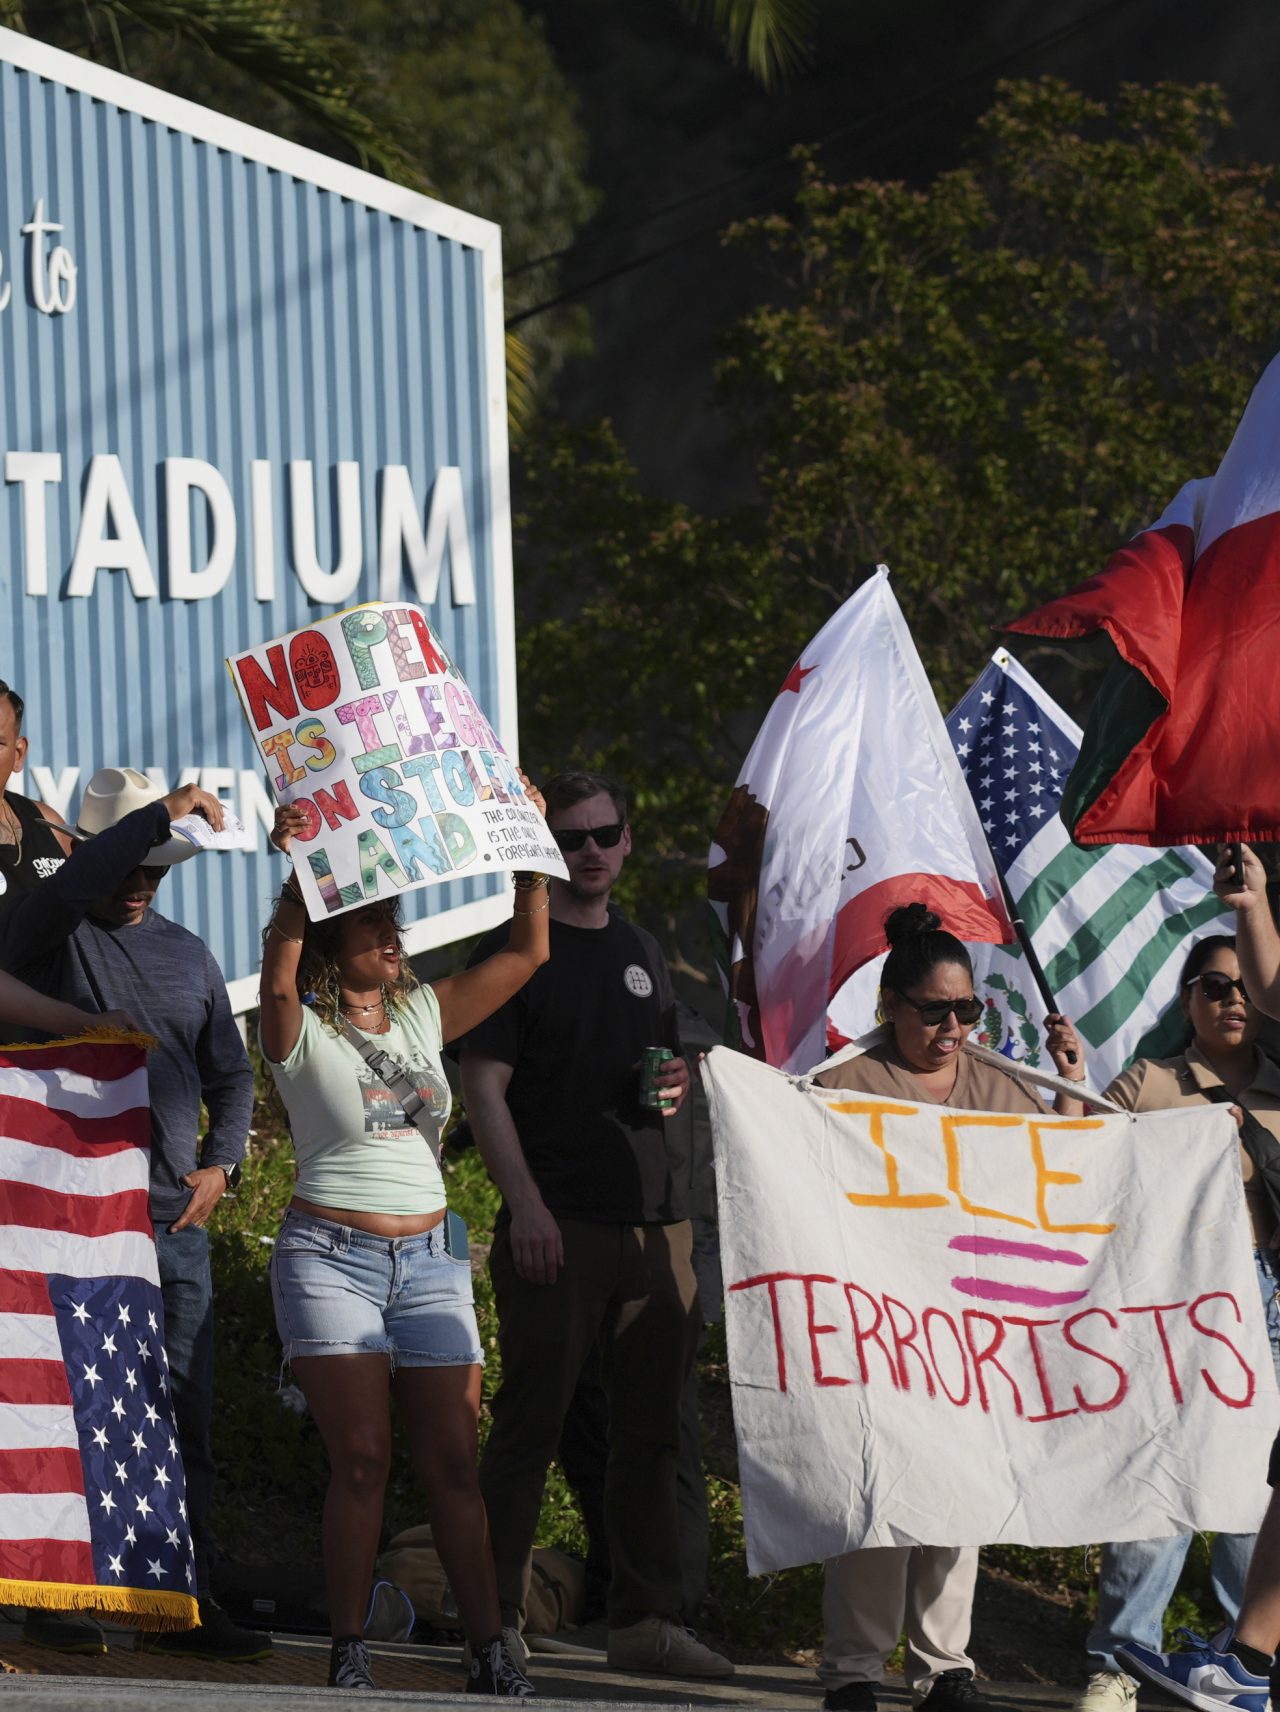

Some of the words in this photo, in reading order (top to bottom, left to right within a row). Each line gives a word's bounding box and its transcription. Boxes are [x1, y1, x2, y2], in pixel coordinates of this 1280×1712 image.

[22, 199, 78, 314] to
[235, 629, 342, 732] NO
[261, 717, 337, 791] IS
[291, 779, 361, 842] ON
[359, 749, 528, 829] STOLEN
[307, 812, 478, 914] LAND
[482, 808, 504, 824] THE
[487, 829, 500, 843] IS
[499, 825, 522, 842] THE
[829, 1101, 1116, 1234] ICE
[728, 1272, 1256, 1423] TERRORISTS
